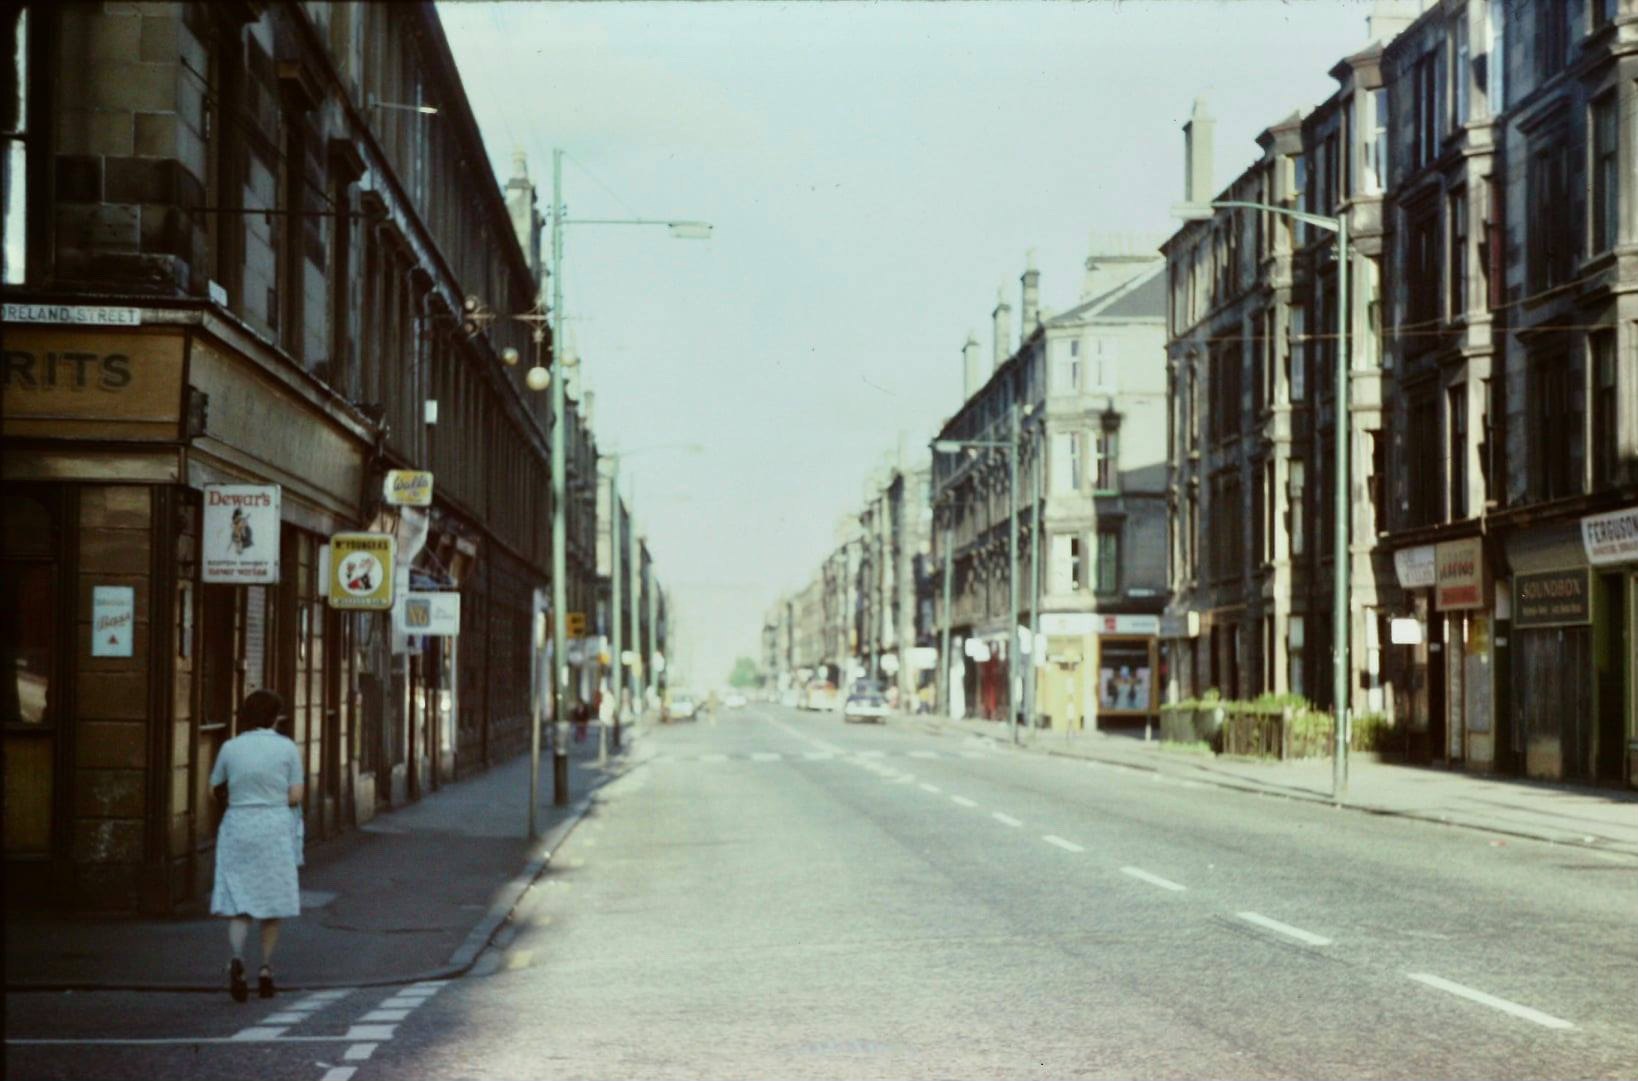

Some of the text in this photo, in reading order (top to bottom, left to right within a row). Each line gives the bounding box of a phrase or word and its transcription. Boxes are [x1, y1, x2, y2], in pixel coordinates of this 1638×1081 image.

[77, 307, 137, 323] STREET
[4, 351, 132, 390] RITS
[208, 491, 270, 507] Dewar's
